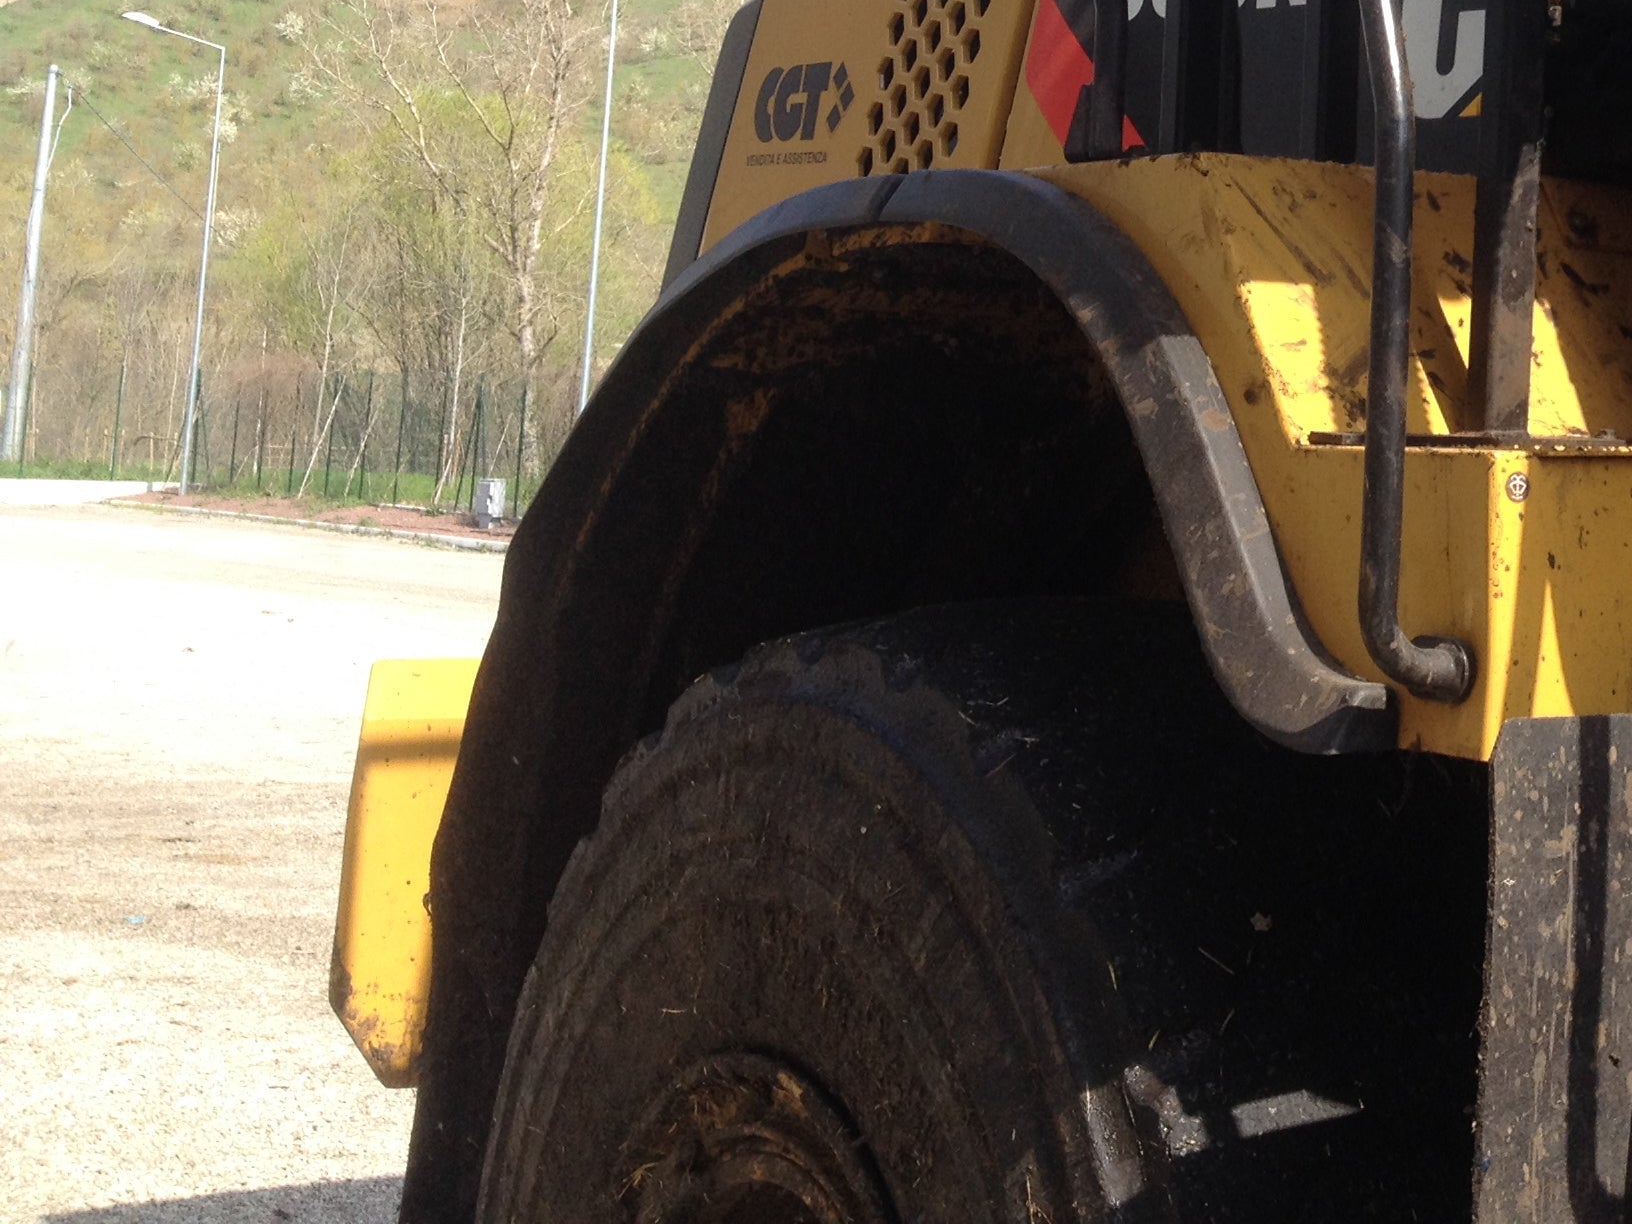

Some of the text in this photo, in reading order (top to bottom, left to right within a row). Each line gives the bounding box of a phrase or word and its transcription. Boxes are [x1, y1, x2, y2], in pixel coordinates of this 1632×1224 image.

[754, 61, 833, 143] CGT
[776, 153, 782, 165] E
[782, 151, 828, 165] ASSISTENZA
